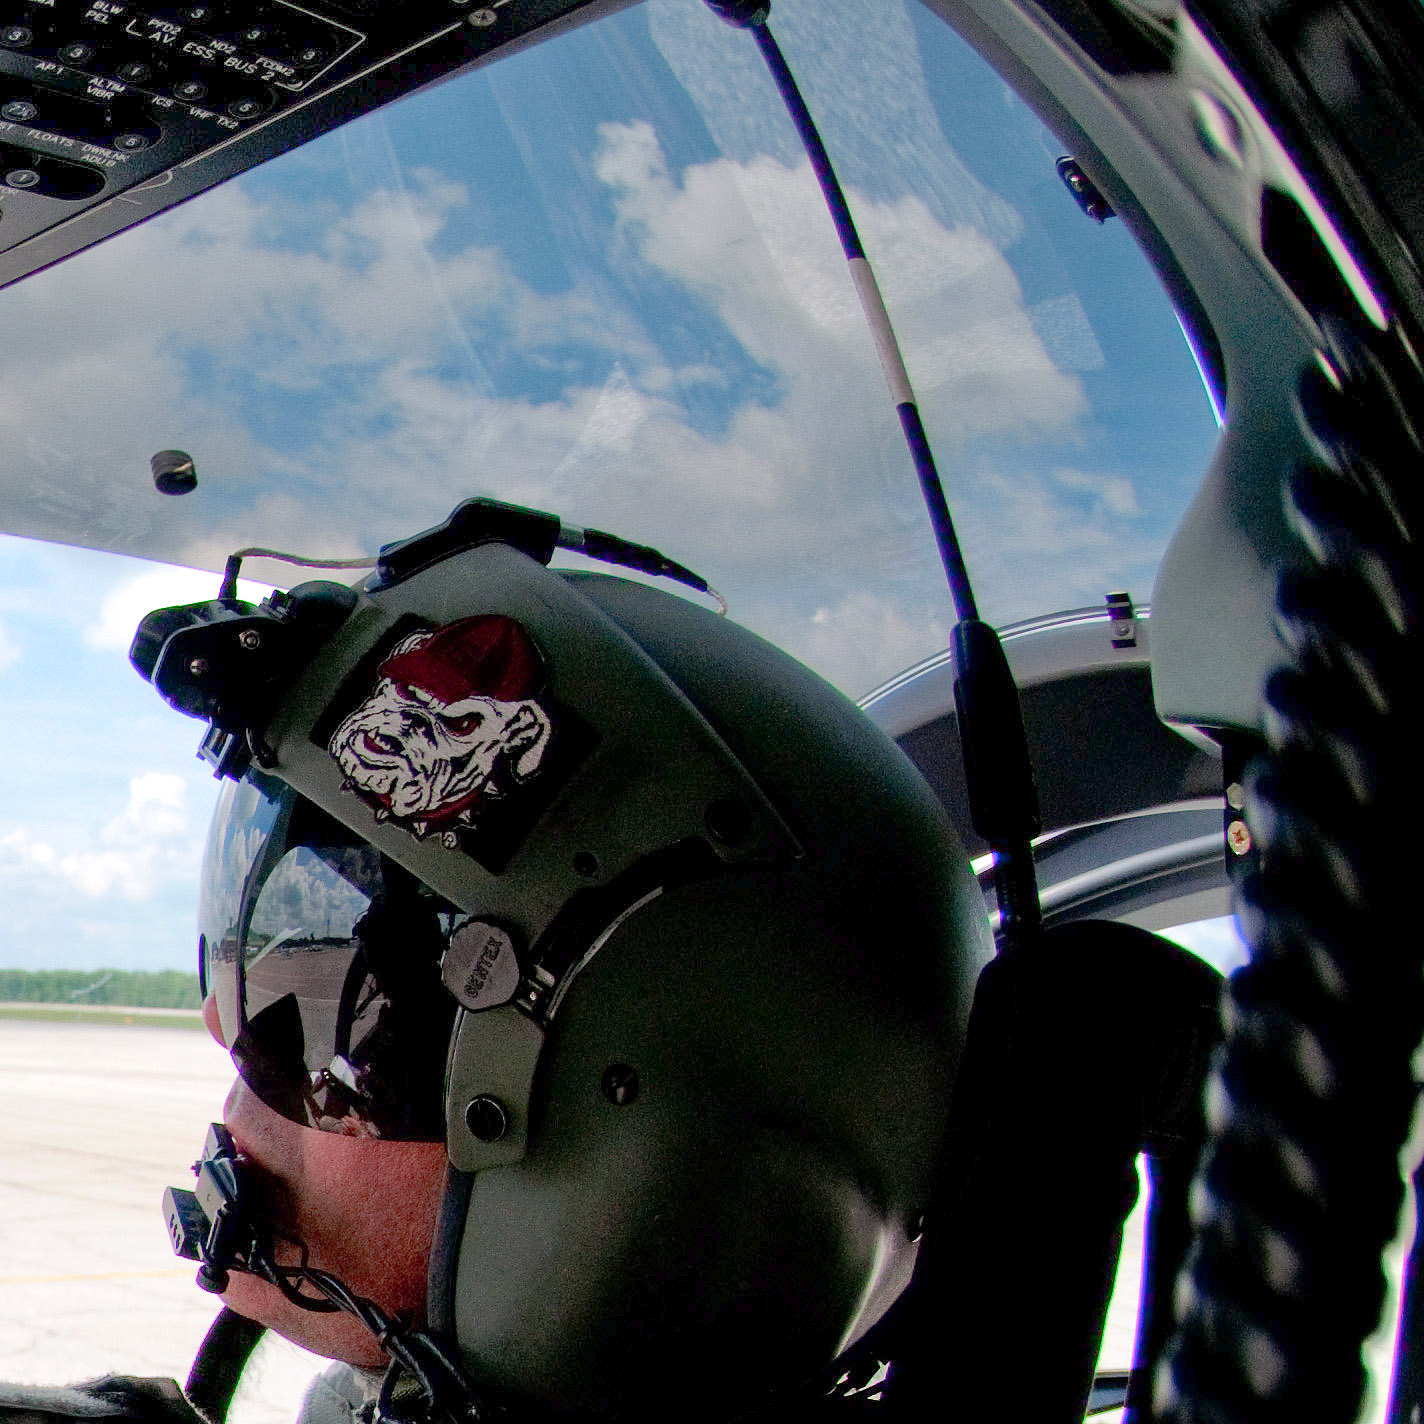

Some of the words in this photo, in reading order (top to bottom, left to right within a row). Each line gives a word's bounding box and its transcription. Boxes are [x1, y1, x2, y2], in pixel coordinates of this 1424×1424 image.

[223, 57, 258, 75] BUS
[261, 71, 275, 81] 2
[27, 130, 74, 147] FLOATS
